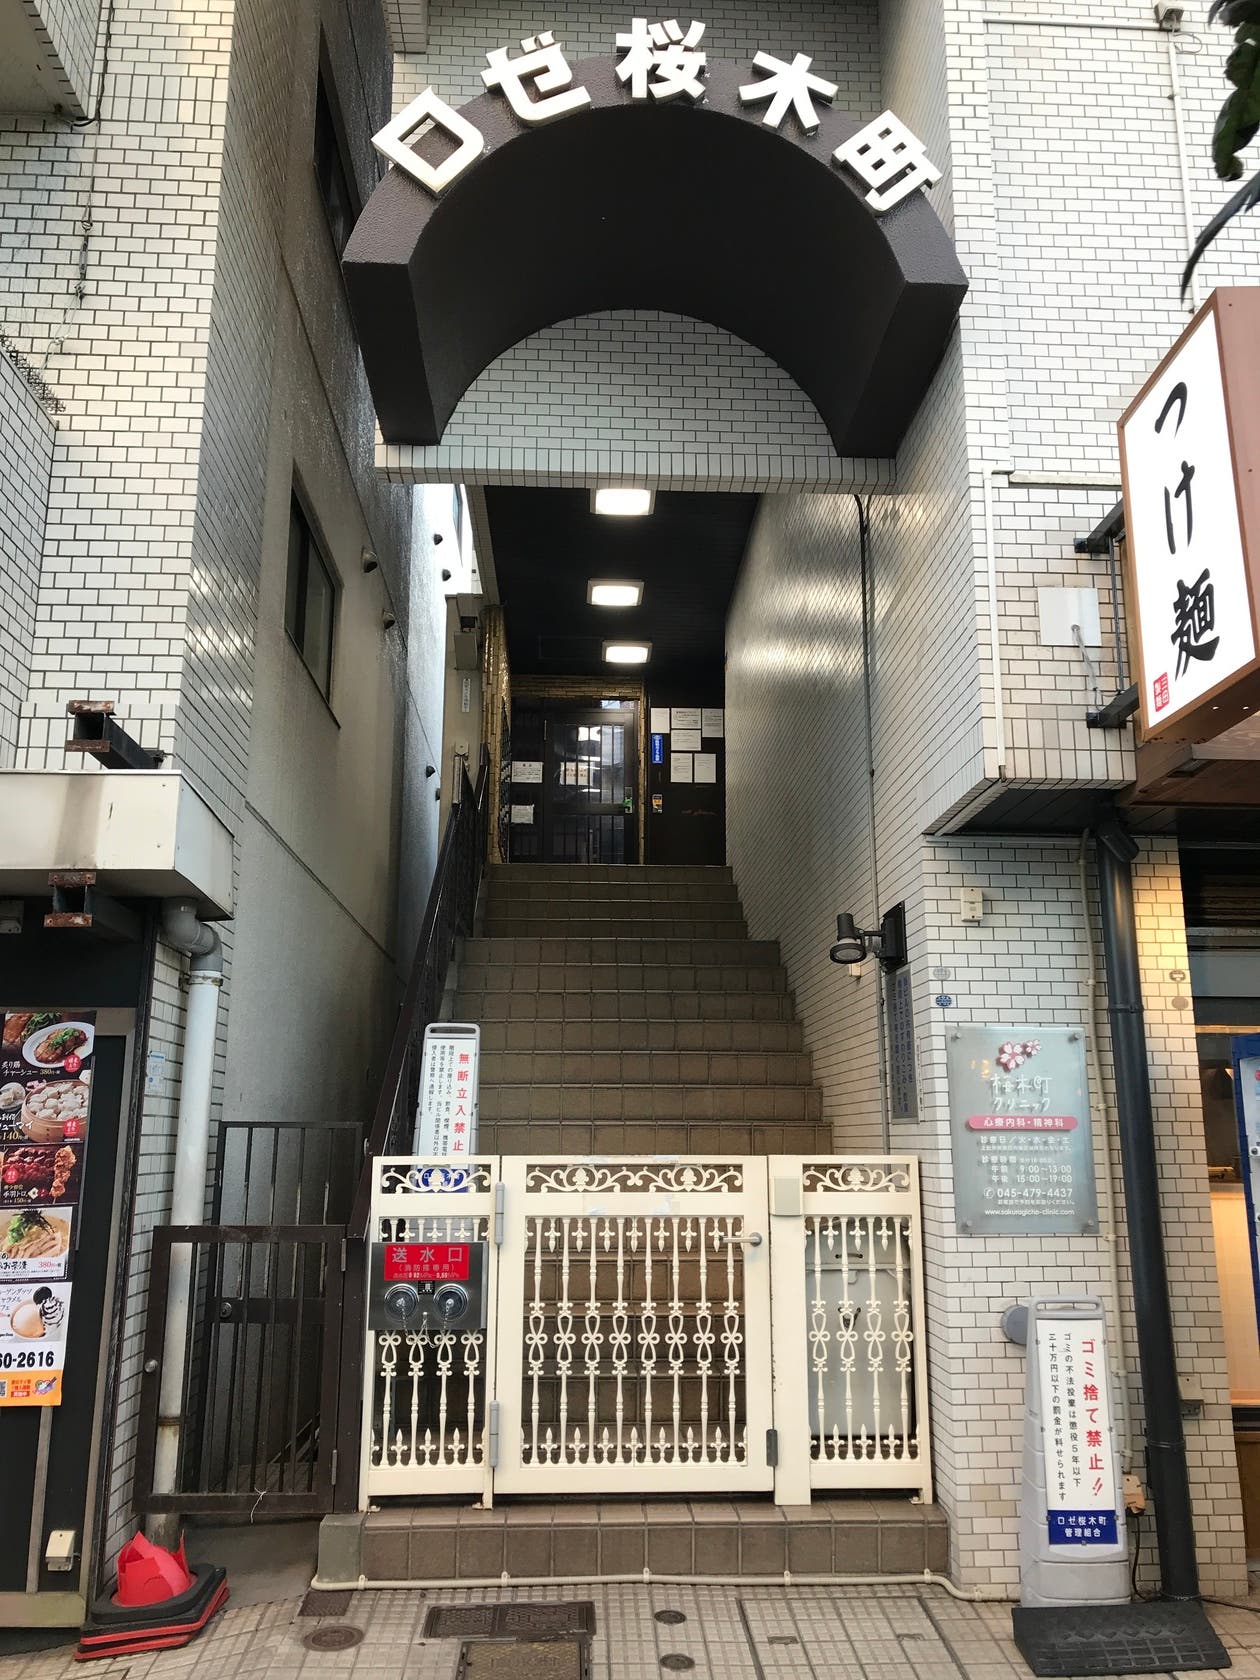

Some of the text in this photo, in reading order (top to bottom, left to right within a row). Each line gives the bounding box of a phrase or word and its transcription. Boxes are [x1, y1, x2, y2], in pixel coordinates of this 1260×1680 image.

[371, 17, 943, 214] ロゼ桜木町
[1154, 381, 1220, 681] つけ麺
[990, 1073, 1053, 1094] 桜木町
[453, 1052, 470, 1152] 無断立入禁止
[992, 1097, 1051, 1113] クリニック
[983, 1117, 1064, 1127] 心療内科・精神科
[991, 1165, 1008, 1173] 午前
[991, 1174, 1008, 1183] 午後
[997, 1187, 1073, 1198] 045-479-4437
[984, 1207, 1075, 1217] www.sakuragicho-clinic.com
[391, 1246, 463, 1263] 送水口
[1063, 1332, 1082, 1489] ゴミの不法投棄は懲役5年以下
[1057, 1515, 1107, 1526] ロゼ桜木町
[1064, 1527, 1102, 1538] 管理組合
